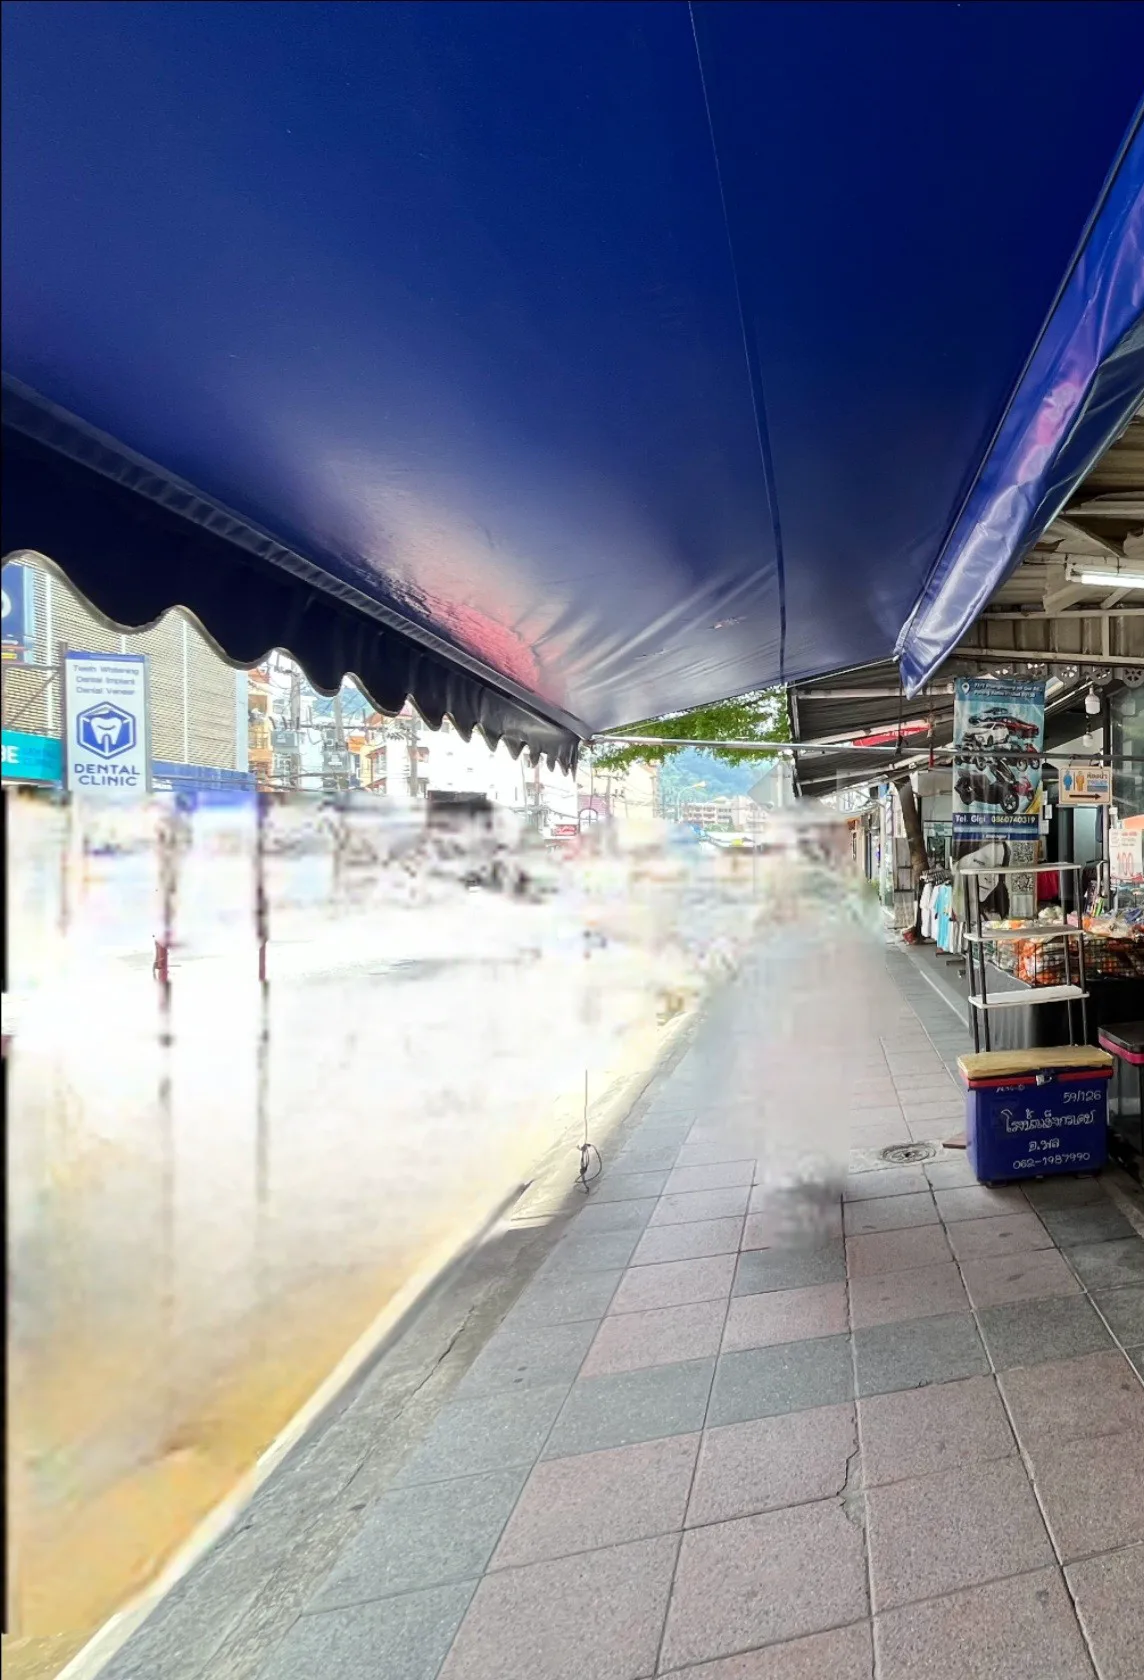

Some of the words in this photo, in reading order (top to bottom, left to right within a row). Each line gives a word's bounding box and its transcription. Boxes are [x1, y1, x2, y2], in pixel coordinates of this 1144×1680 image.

[74, 763, 141, 776] DENTAL
[78, 775, 138, 787] CLINIC
[1063, 1090, 1103, 1104] 59/126
